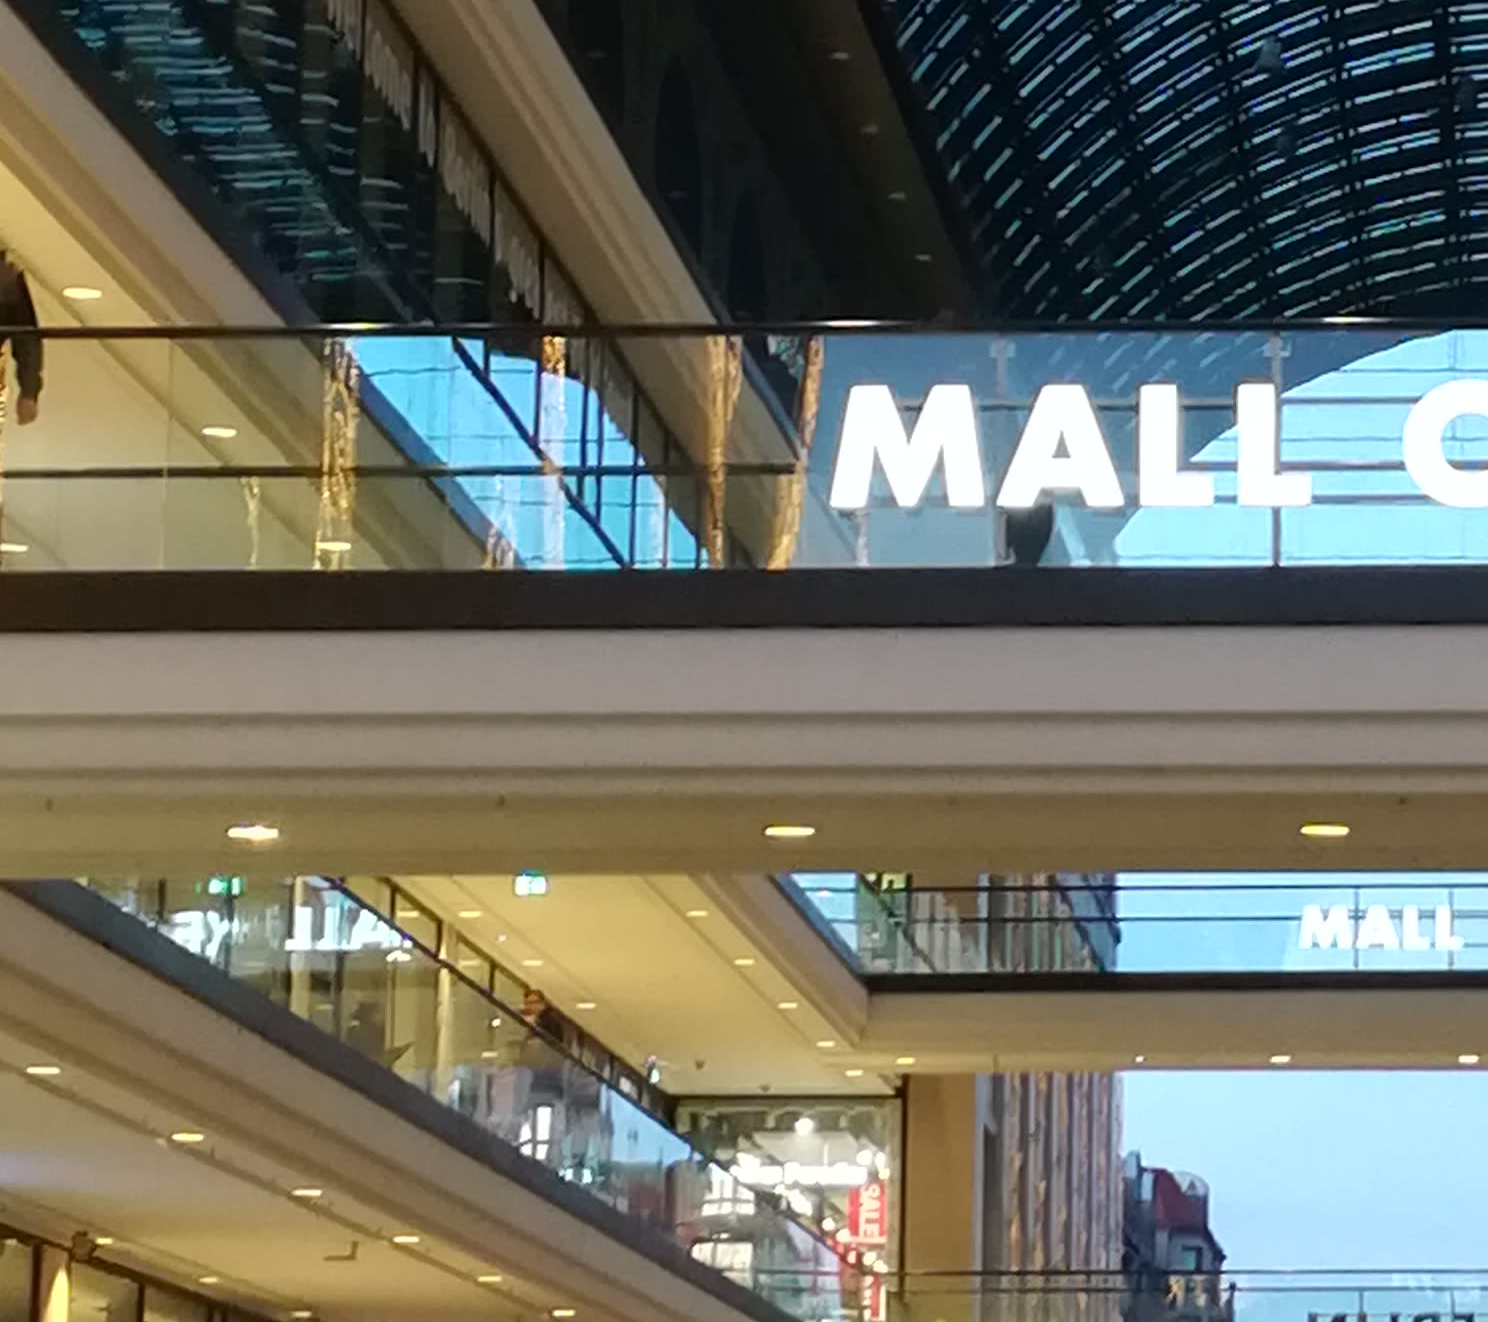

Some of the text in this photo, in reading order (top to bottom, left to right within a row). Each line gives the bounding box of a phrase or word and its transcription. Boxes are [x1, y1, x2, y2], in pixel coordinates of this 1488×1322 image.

[828, 381, 1313, 509] MALL
[1299, 904, 1464, 952] MALL
[859, 1184, 881, 1238] SALE
